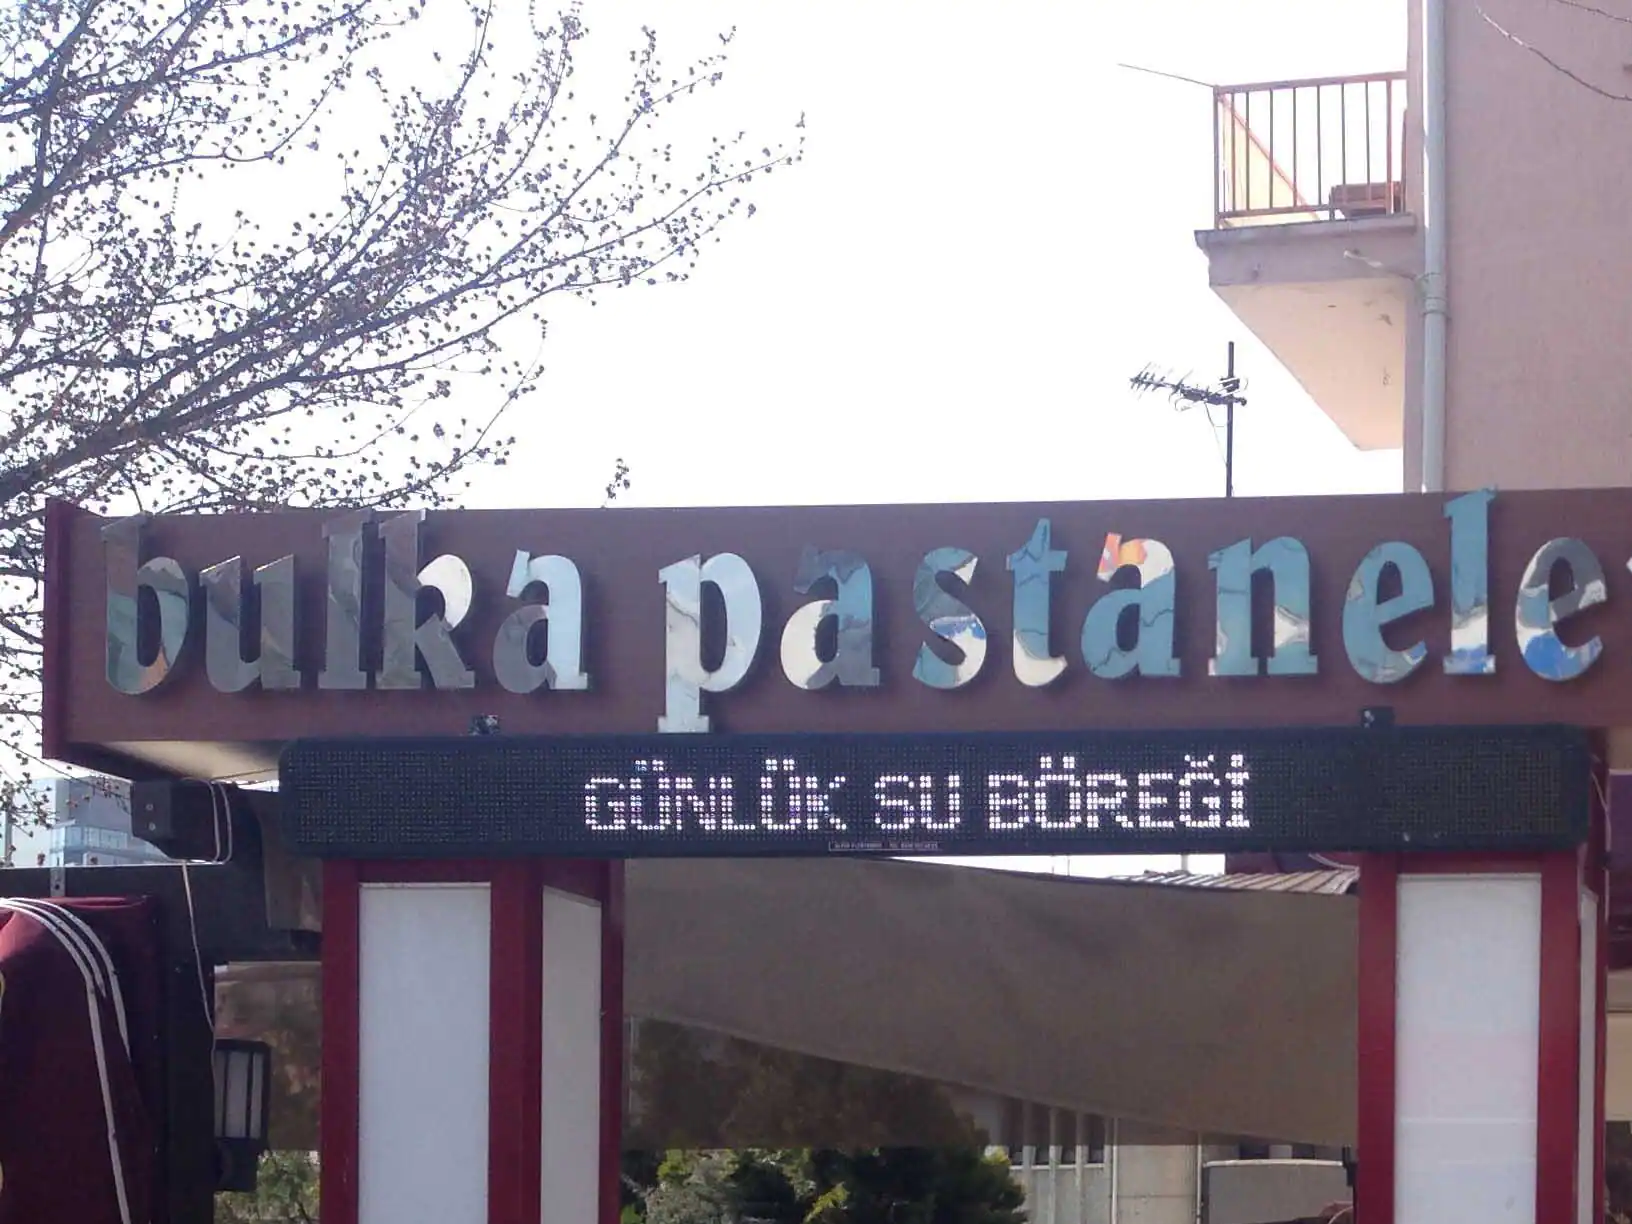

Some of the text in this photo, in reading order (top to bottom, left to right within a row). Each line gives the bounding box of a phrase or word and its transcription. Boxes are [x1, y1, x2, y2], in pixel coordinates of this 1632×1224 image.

[101, 508, 592, 694] bulka
[584, 753, 1250, 830] GÜNLÜK SU BÖREĞİ
